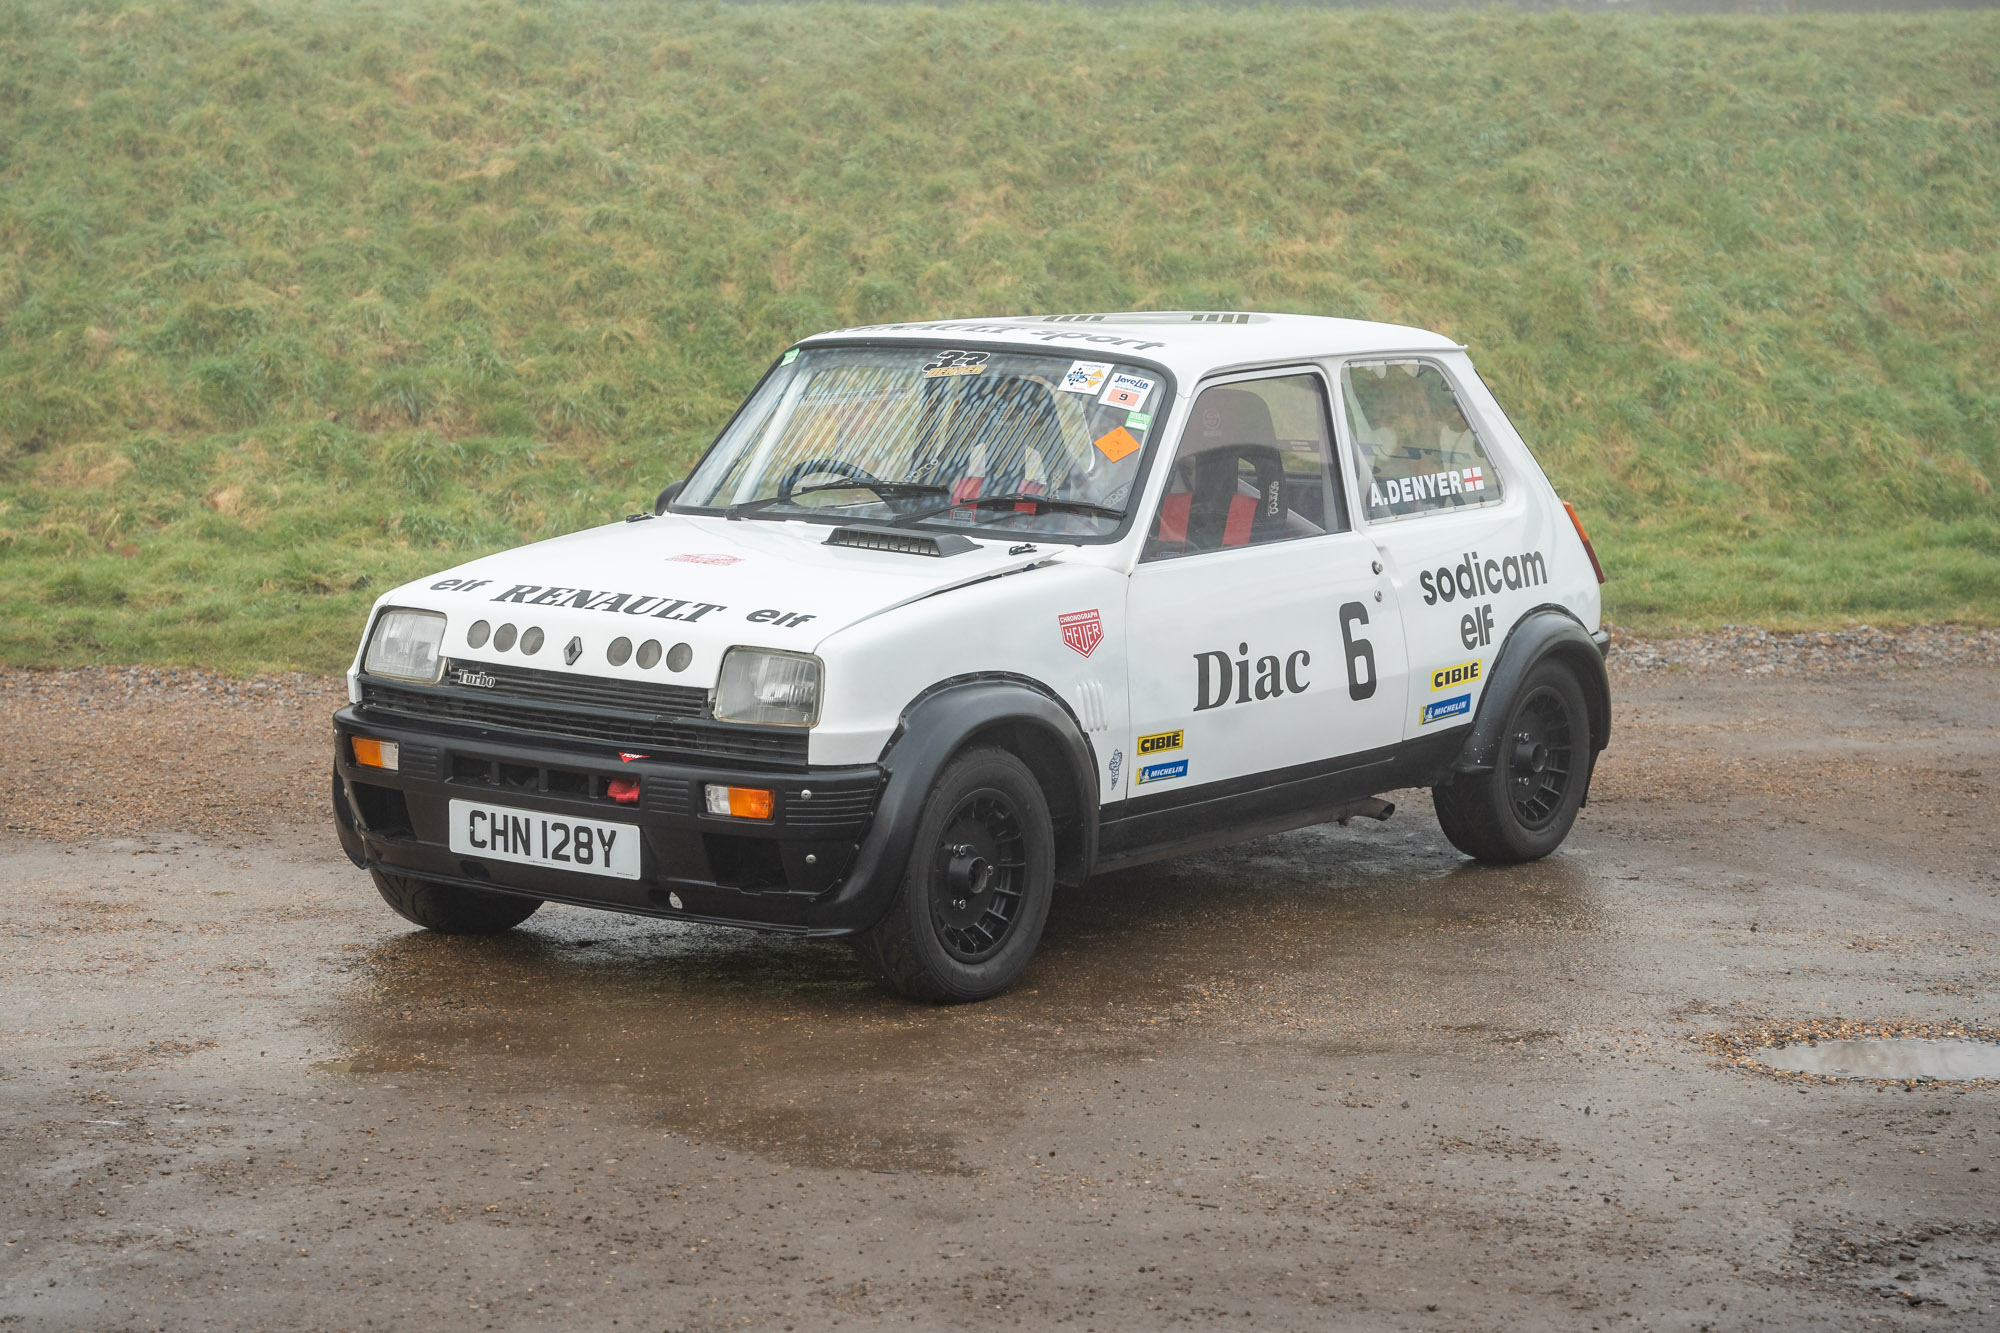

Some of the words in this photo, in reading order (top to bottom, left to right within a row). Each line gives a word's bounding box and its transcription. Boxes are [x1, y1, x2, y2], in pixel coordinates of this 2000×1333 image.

[1031, 330, 1166, 350] sport
[1114, 375, 1149, 390] Javelin
[1118, 393, 1129, 401] 9
[1268, 480, 1280, 517] sparco
[1370, 470, 1463, 508] A.DENYER
[1419, 551, 1548, 606] sodicam
[430, 578, 494, 592] elf
[489, 584, 728, 623] RENAULT
[745, 609, 817, 628] elf
[1059, 611, 1098, 624] CHRONOGRAPH
[1064, 623, 1101, 652] HEUER
[1460, 603, 1495, 650] elf
[1338, 601, 1377, 701] 6
[458, 668, 496, 688] Turbo
[1193, 641, 1311, 712] Diac
[1434, 701, 1467, 717] MICHELIN
[1150, 765, 1184, 778] MICHELIN
[469, 809, 531, 857] CHN
[541, 820, 617, 868] 128Y
